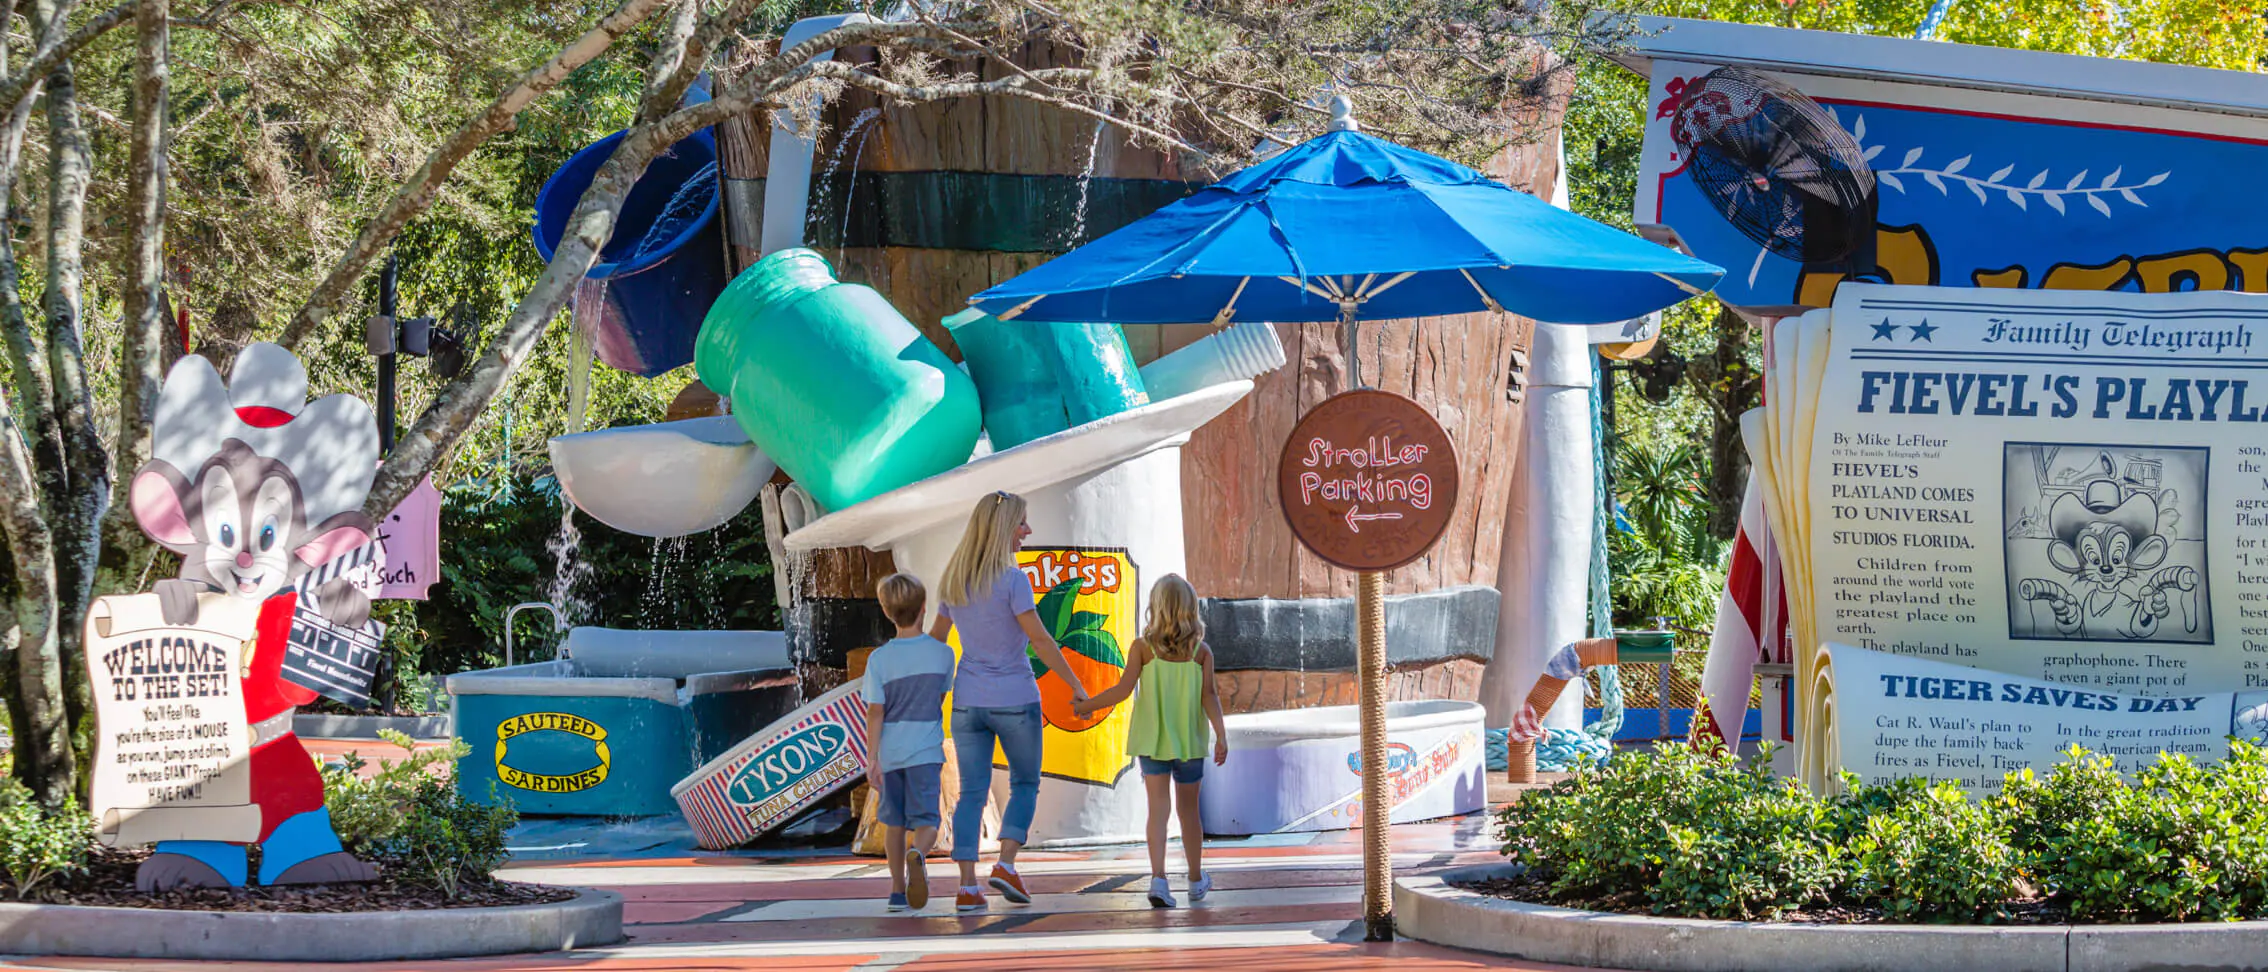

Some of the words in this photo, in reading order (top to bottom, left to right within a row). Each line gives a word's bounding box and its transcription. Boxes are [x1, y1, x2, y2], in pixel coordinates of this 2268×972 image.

[1982, 318, 2091, 351] Family
[2102, 321, 2252, 355] Telegraph
[1857, 371, 2080, 419] FIEVEL'S
[2093, 376, 2268, 422] PLAYL
[1834, 432, 1850, 446] By
[1857, 432, 1891, 446] Mike
[1897, 434, 1949, 447] LeFleur
[1844, 449, 1857, 457] The
[1887, 450, 1921, 459] Telegraph
[1832, 463, 1919, 478] FIEVEL'S
[2238, 460, 2261, 473] the
[1300, 472, 1431, 509] Parking
[1832, 484, 1916, 500] PLAYLAND
[1922, 487, 1975, 502] COMES
[1832, 505, 1858, 519] TO
[1864, 507, 1974, 524] UNIVERSAL
[1833, 531, 1898, 546] STUDIOS
[1903, 534, 1975, 549] FLORIDA.
[2236, 535, 2256, 548] for
[1857, 557, 1927, 572] Children
[1935, 560, 1973, 573] from
[1833, 574, 1878, 586] around
[1883, 575, 1904, 587] the
[1908, 576, 1943, 589] world
[1949, 580, 1975, 590] vote
[1835, 589, 1862, 601] the
[1869, 590, 1940, 605] playland
[1949, 593, 1976, 606] the
[2238, 592, 2261, 601] one
[1836, 608, 1899, 619] greatest
[1907, 608, 1949, 622] place
[1955, 614, 1976, 623] on
[1836, 622, 1876, 634] earth.
[103, 637, 227, 676] WELCOME
[1859, 638, 1887, 652] The
[1892, 640, 1949, 656] playland
[1955, 643, 1978, 657] has
[2043, 653, 2139, 669] graphophone.
[2145, 655, 2187, 669] There
[2244, 660, 2259, 670] as
[112, 677, 136, 701] TO
[143, 675, 180, 699] THE
[187, 673, 228, 697] SET!
[2044, 670, 2054, 682] is
[2059, 673, 2089, 684] even
[2094, 674, 2101, 685] a
[2106, 672, 2142, 687] giant
[2146, 674, 2167, 687] pot
[2173, 673, 2187, 687] of
[1880, 674, 1993, 701] TIGER
[2001, 683, 2118, 712] SAVES
[2128, 696, 2206, 713] DAY
[167, 704, 183, 720] feel
[142, 730, 156, 742] the
[176, 724, 186, 740] of
[194, 722, 228, 738] MOUSE
[503, 714, 596, 737] SAUTEED
[1876, 715, 1899, 728] Cat
[1907, 716, 1922, 729] R.
[1929, 716, 1975, 731] Waul's
[1981, 719, 2011, 733] plan
[2018, 722, 2032, 733] to
[2057, 723, 2071, 735] In
[2079, 725, 2101, 738] the
[2106, 726, 2142, 741] great
[2148, 724, 2211, 737] tradition
[1875, 733, 1909, 749] dupe
[1915, 734, 1937, 748] the
[1943, 735, 1987, 750] family
[2054, 740, 2068, 752] of
[2100, 742, 2160, 755] American
[2166, 740, 2211, 753] dream,
[128, 752, 144, 766] you
[164, 746, 185, 763] jump
[188, 747, 204, 759] and
[734, 727, 839, 800] TYSONS
[1874, 752, 1908, 767] fires
[1914, 757, 1929, 767] as
[1937, 753, 1985, 769] Fievel,
[1991, 754, 2031, 771] Tiger
[127, 771, 138, 783] on
[139, 767, 162, 783] these
[164, 764, 192, 781] GIANT
[505, 769, 601, 791] SARDINES
[148, 786, 173, 802] HAVE
[749, 795, 792, 826] TUNA
[793, 755, 856, 799] CHUNKS
